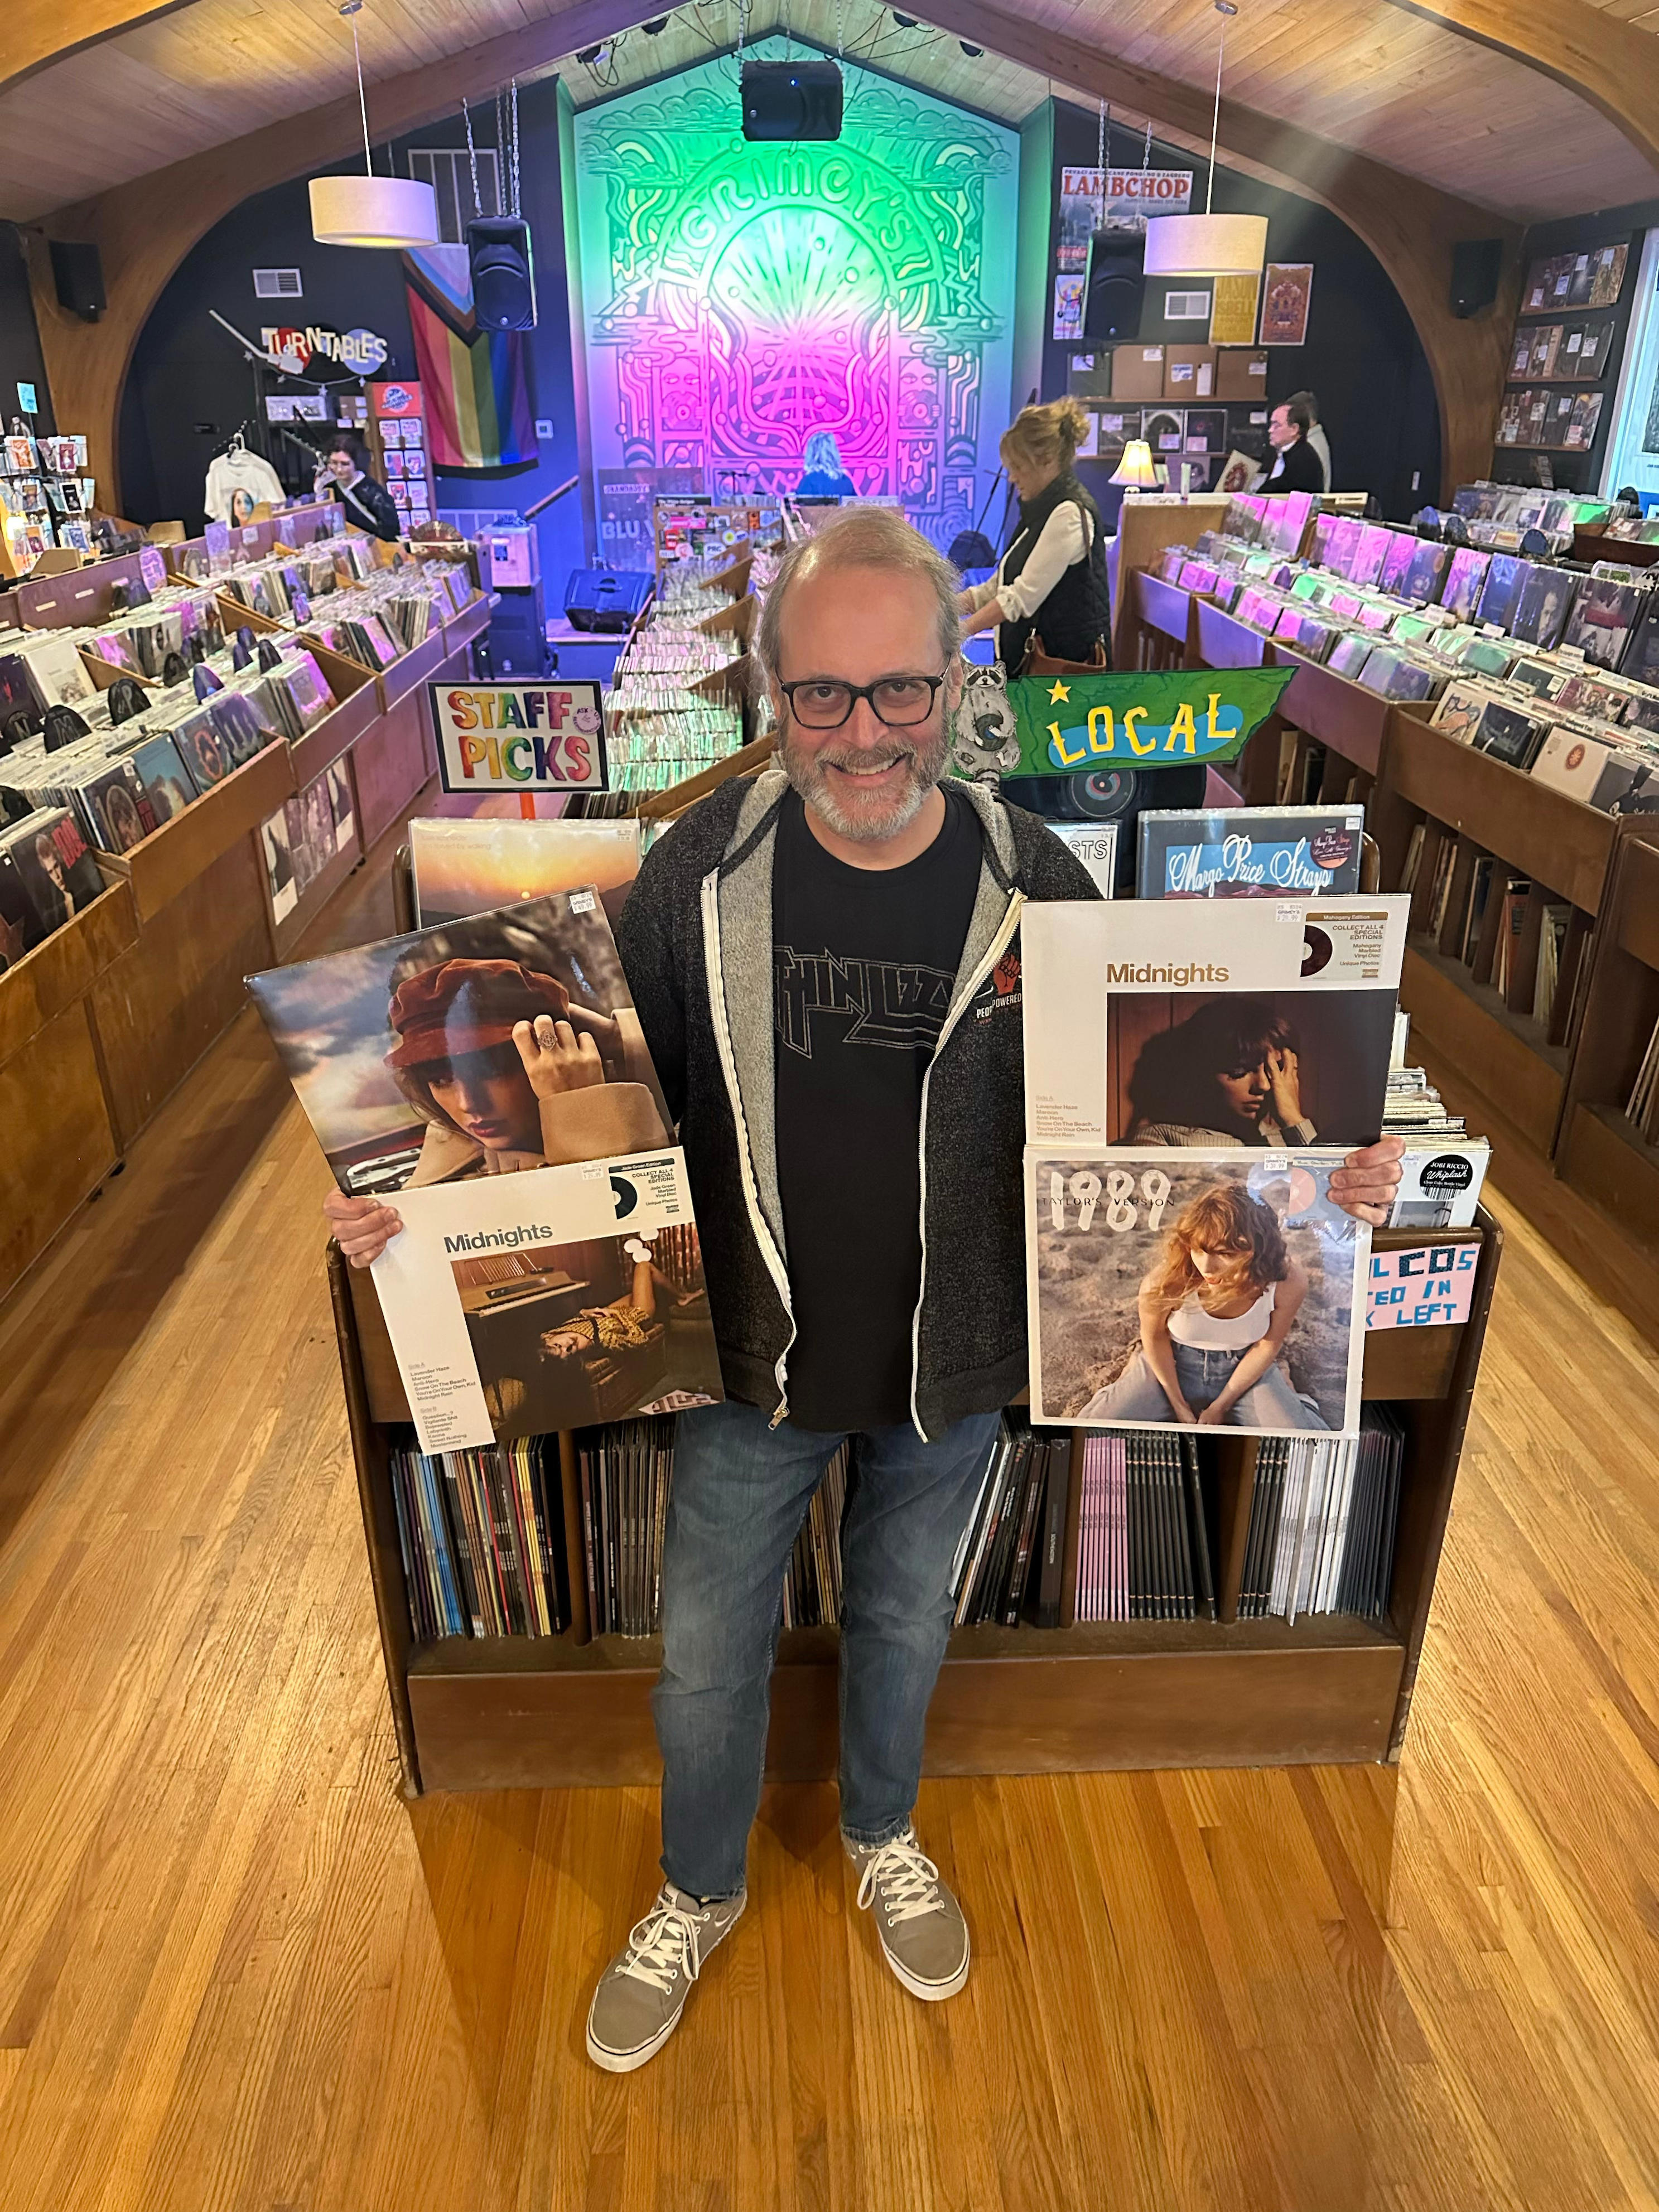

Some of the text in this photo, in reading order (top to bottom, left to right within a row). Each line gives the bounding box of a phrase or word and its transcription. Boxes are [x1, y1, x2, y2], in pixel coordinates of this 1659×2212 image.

[1063, 175, 1189, 198] LAMBCHOP
[261, 326, 388, 364] TURNTABLES
[447, 690, 572, 730] STAFF
[1046, 693, 1237, 765] LOCAL
[457, 735, 591, 781] PICKS
[1169, 834, 1332, 897] Margo Price Strays
[1107, 962, 1229, 987] Midnights
[1426, 1169, 1468, 1181] Whiplash
[1041, 1197, 1102, 1206] TAYLOR'S
[1050, 1169, 1171, 1232] 1989
[443, 1224, 553, 1253] Midnights
[1399, 1247, 1476, 1278] CDS
[1423, 1279, 1451, 1299] IN
[1396, 1302, 1457, 1325] LEFT
